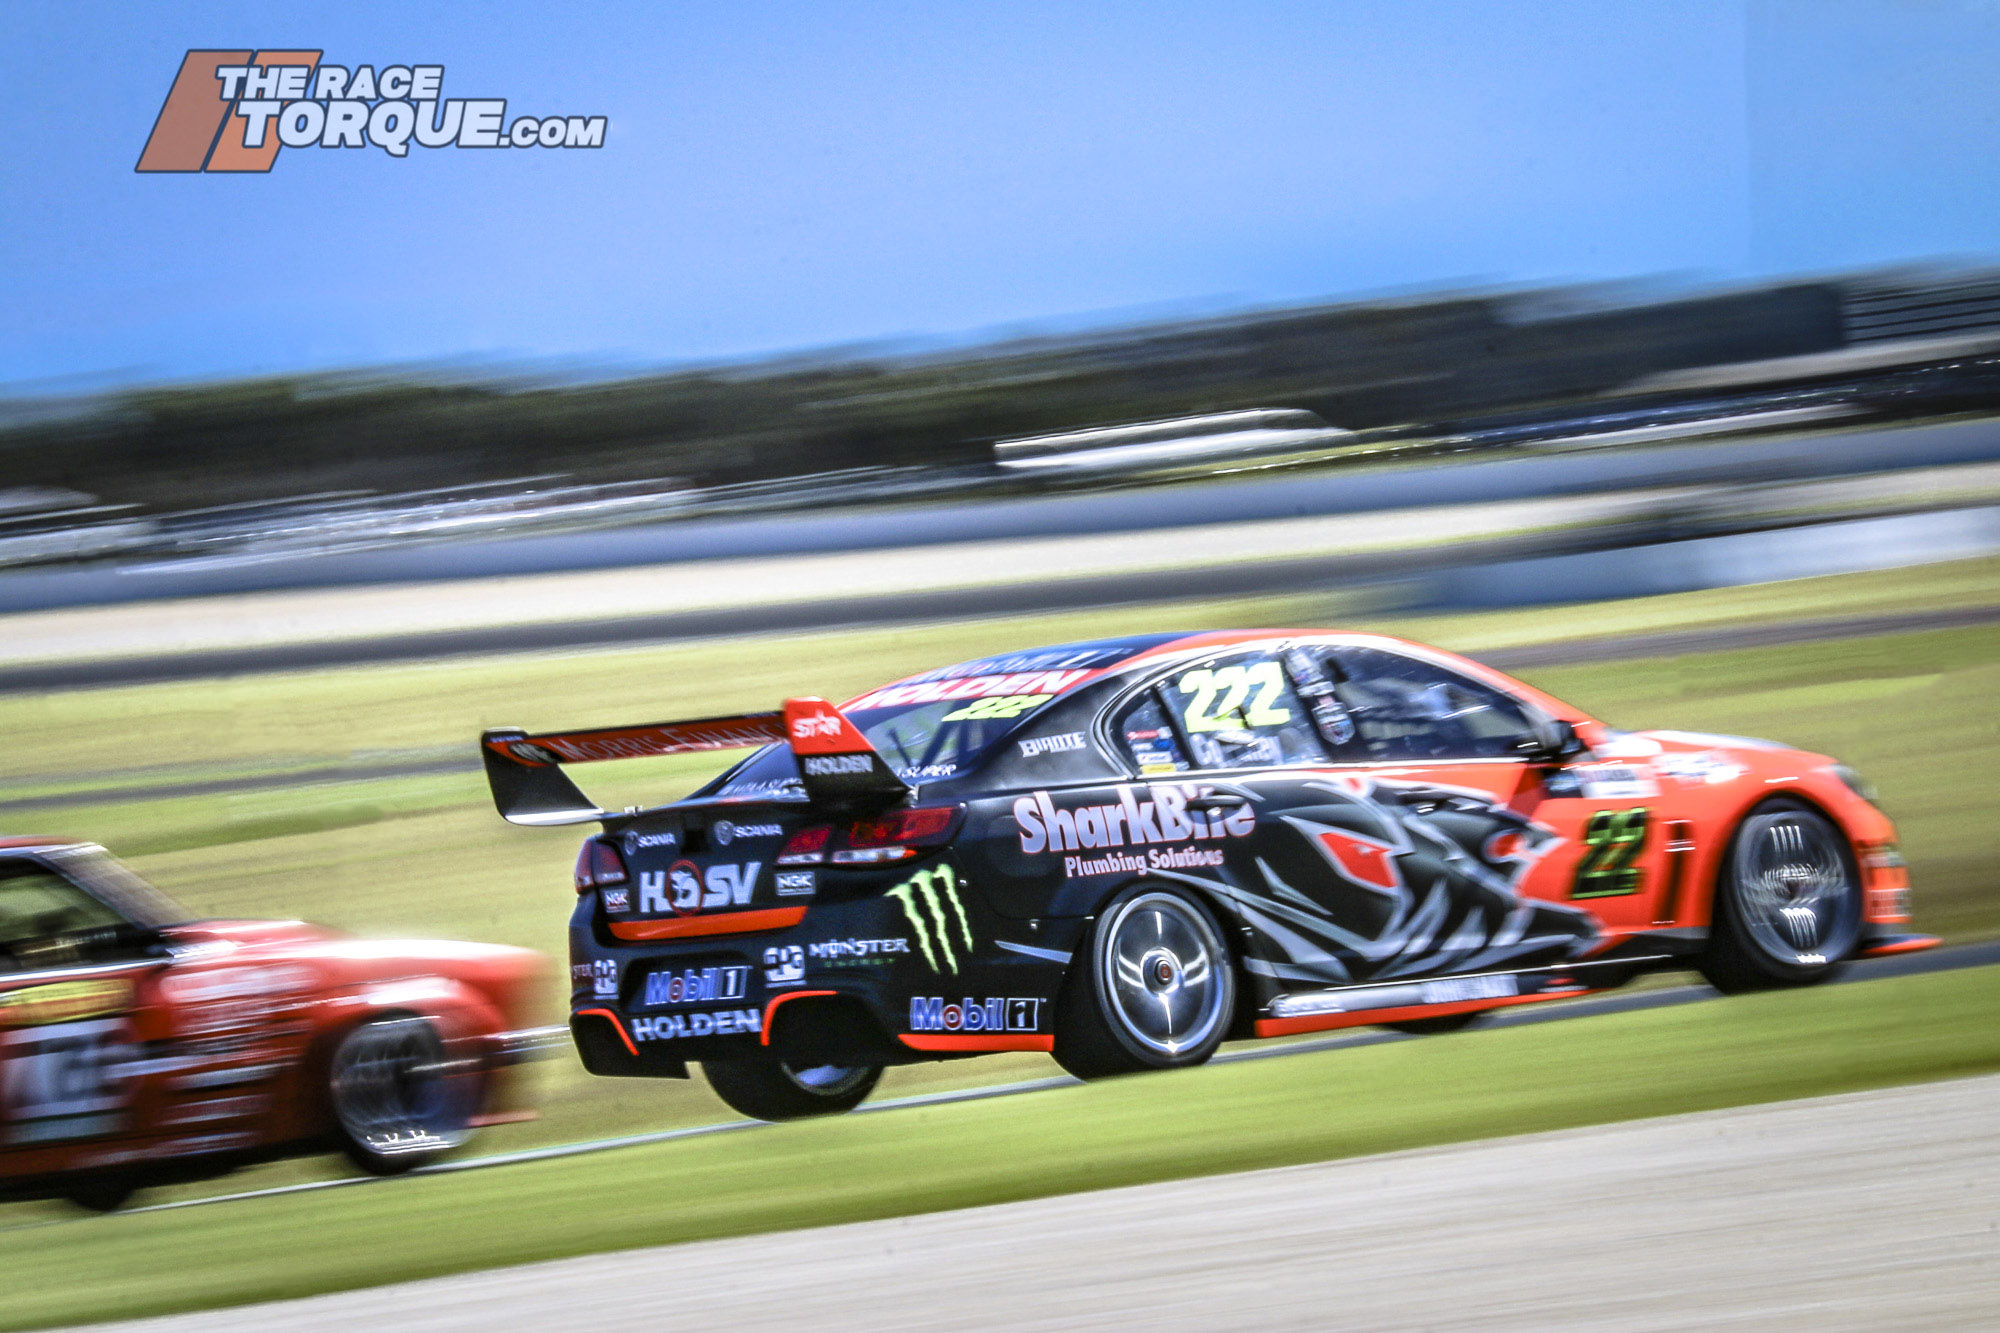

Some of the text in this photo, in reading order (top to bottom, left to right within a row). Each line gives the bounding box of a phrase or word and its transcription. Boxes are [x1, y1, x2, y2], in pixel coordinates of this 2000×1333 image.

[841, 668, 1093, 712] HOLDEN
[1178, 661, 1291, 733] 222
[941, 693, 1055, 722] 222
[792, 710, 842, 738] STAR
[1017, 731, 1088, 758] BIANTE
[803, 754, 874, 776] HOLDEN
[733, 823, 784, 839] SCANIA
[1013, 783, 1256, 854] SharkBite
[637, 832, 677, 849] SCANIA
[1064, 846, 1225, 878] Plumbing Solutions
[809, 938, 911, 958] MONSTER
[645, 968, 719, 1006] Mobil
[631, 1008, 763, 1042] HOLDEN
[910, 996, 1004, 1031] Mobil
